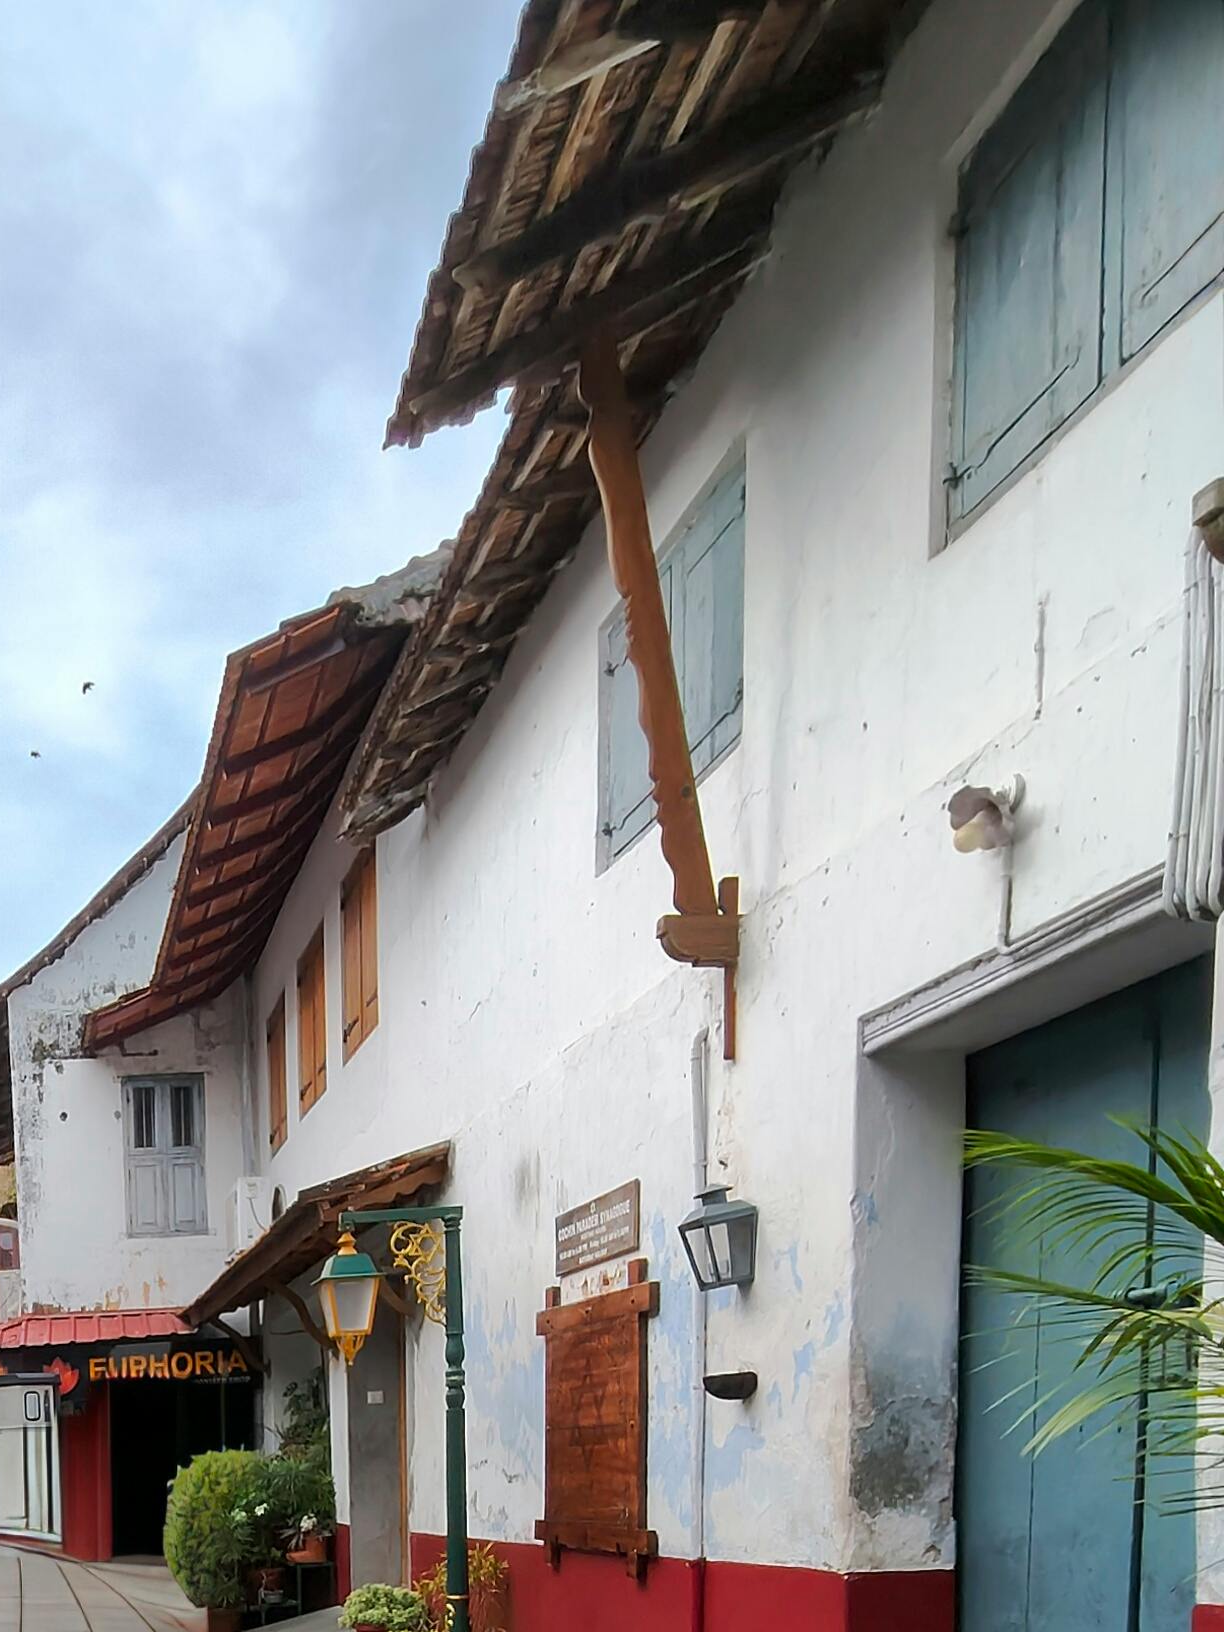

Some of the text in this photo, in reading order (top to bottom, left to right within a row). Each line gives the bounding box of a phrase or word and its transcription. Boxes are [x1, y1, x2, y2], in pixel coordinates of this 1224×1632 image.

[558, 1223, 576, 1242] COCHIN
[600, 1199, 630, 1225] SYNAGOGUE
[88, 1350, 248, 1381] EUPHORIA
